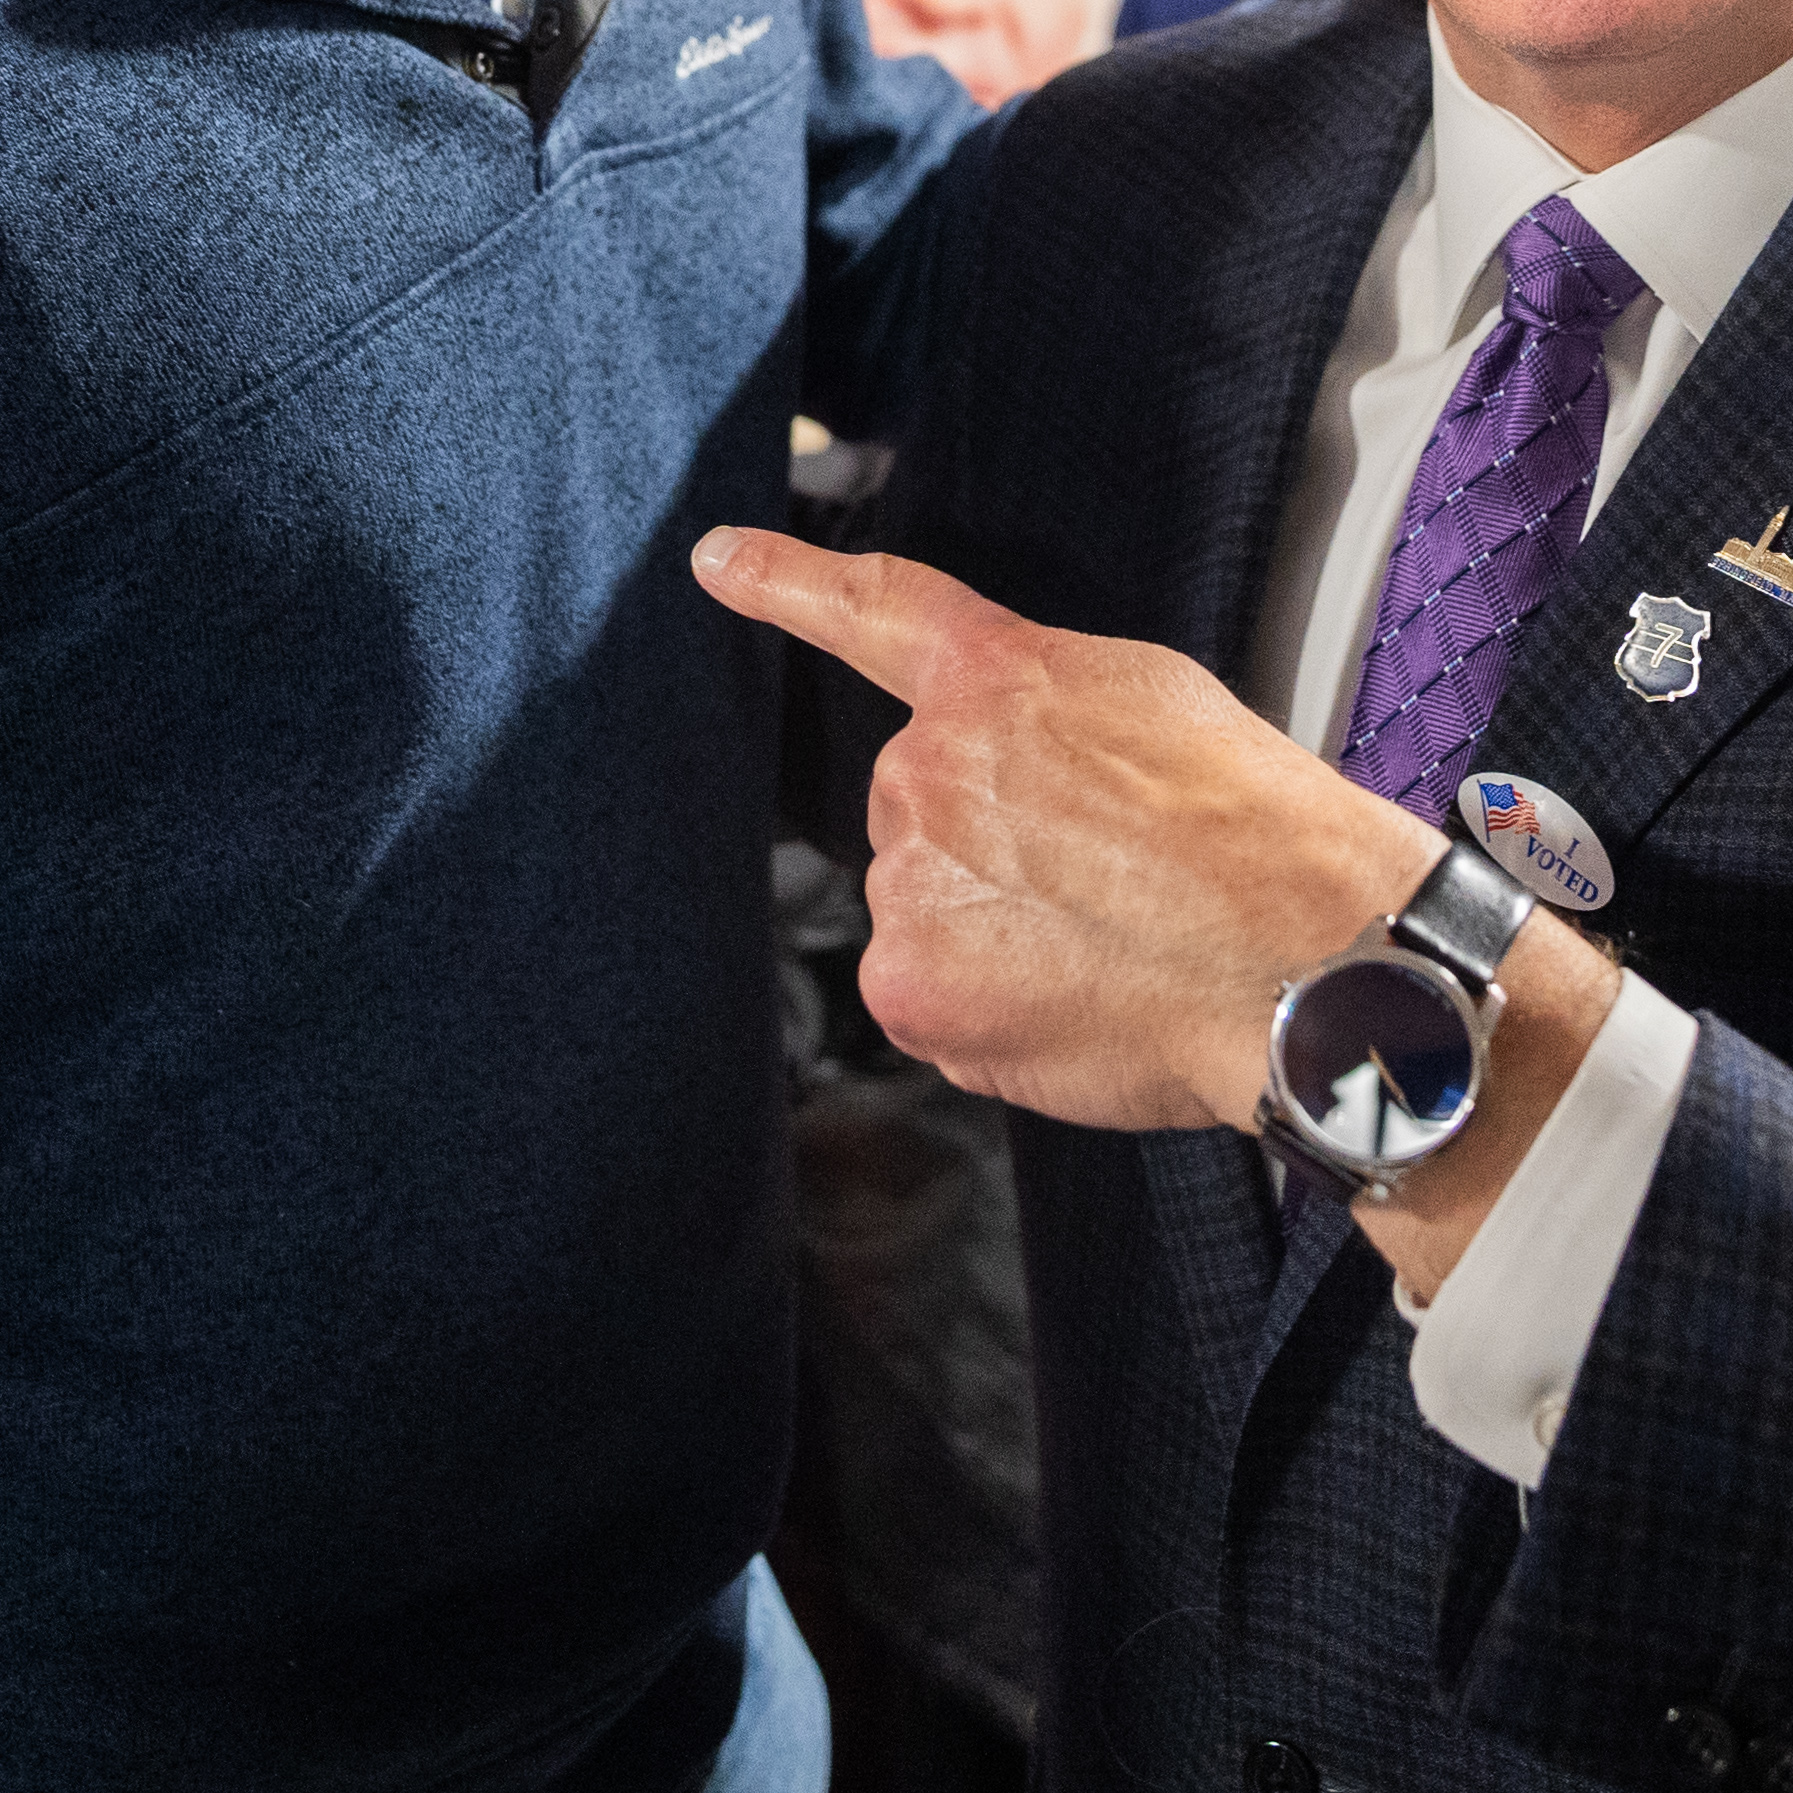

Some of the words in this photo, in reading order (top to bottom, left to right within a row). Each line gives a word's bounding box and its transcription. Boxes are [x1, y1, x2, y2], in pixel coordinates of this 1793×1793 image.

[1649, 621, 1685, 669] 7
[1526, 834, 1600, 904] VOTED
[1563, 837, 1581, 860] I
